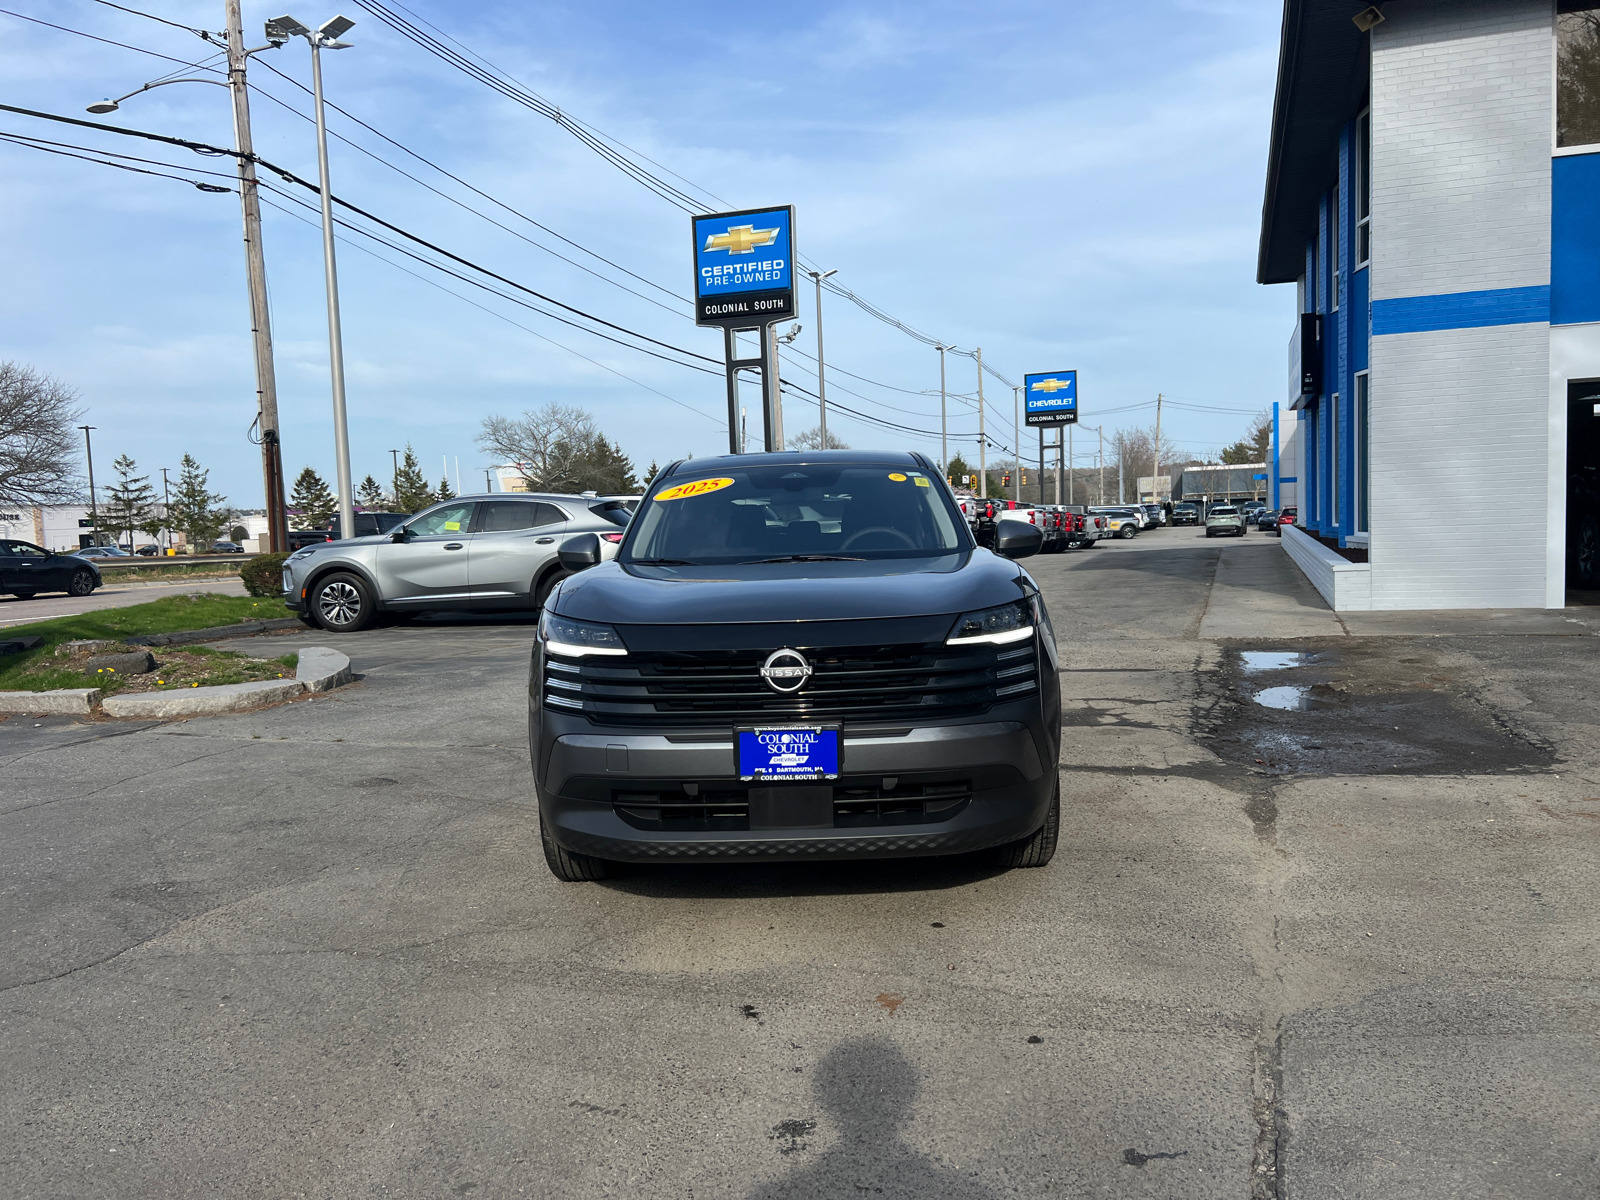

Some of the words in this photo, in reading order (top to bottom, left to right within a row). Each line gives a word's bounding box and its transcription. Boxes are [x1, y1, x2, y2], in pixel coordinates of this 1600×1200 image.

[702, 260, 784, 276] CERTIFIED
[706, 271, 780, 286] PRE-OWNED
[706, 303, 749, 314] COLONIAL
[754, 299, 783, 310] SOUTH
[1029, 398, 1073, 407] CHEVROLET
[668, 479, 722, 499] 2025
[761, 667, 812, 677] NISSAN
[758, 734, 818, 744] COLONIAL
[768, 744, 809, 753] SOUTH
